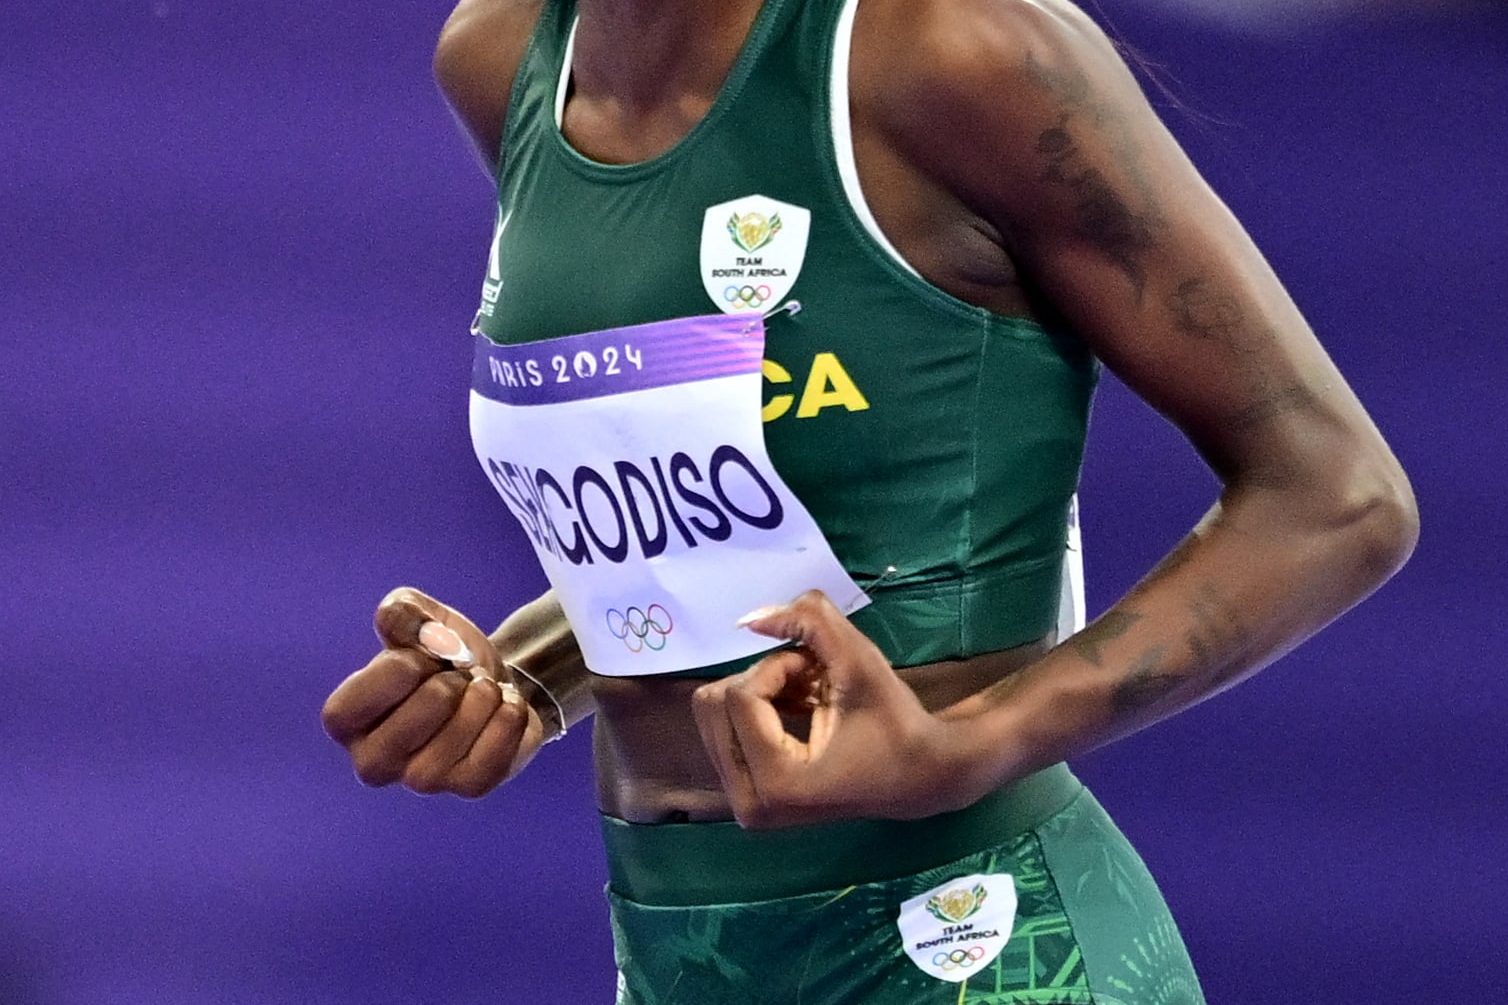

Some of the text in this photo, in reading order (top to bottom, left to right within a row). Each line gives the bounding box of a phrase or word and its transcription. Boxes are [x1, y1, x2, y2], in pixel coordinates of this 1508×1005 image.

[736, 257, 763, 266] TEAM
[711, 268, 787, 278] SOUTH AFRICA
[551, 344, 642, 383] 2024
[942, 924, 974, 936] TEAM
[916, 929, 1000, 950] SOUTH AFRICA
